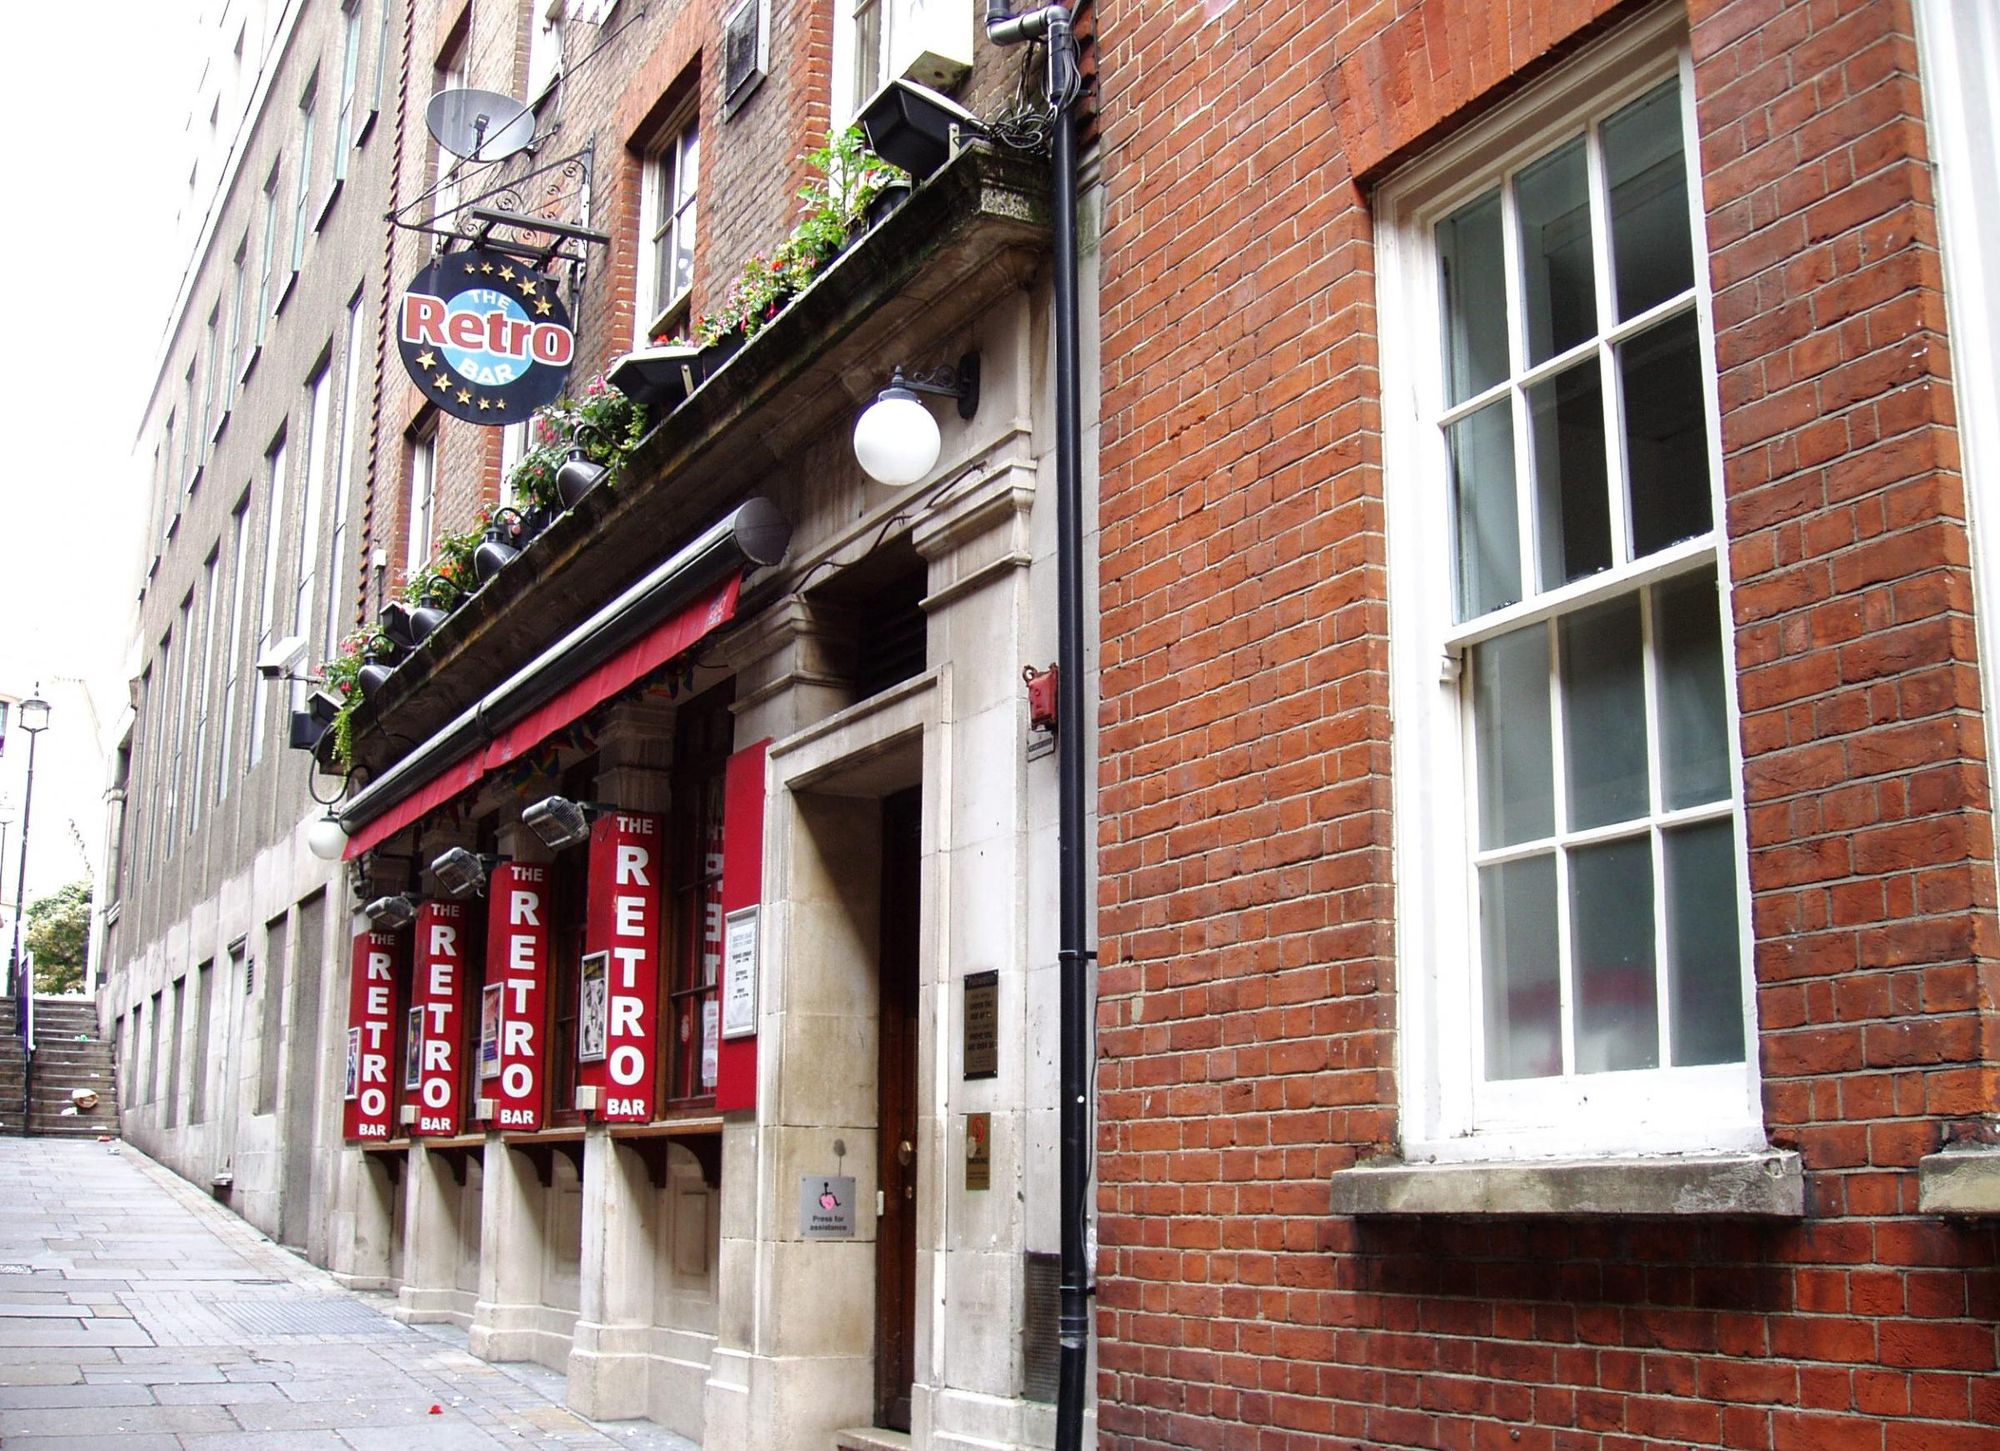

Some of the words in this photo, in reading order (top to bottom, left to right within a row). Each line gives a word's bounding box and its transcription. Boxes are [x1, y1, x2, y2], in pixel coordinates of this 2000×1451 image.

[467, 289, 512, 312] THE
[404, 294, 573, 365] Retro
[458, 357, 517, 385] BAR
[617, 815, 653, 835] THE
[511, 866, 543, 882] THE
[431, 903, 460, 917] THE
[369, 932, 396, 945] THE
[610, 845, 650, 1086] RETRO
[503, 891, 540, 1098] RETRO
[423, 925, 457, 1109] RETRO
[361, 952, 392, 1117] RETRO
[607, 1099, 645, 1116] BAR
[421, 1117, 451, 1131] BAR
[501, 1109, 534, 1125] BAR
[358, 1123, 386, 1136] BAR
[812, 1215, 833, 1223] Press
